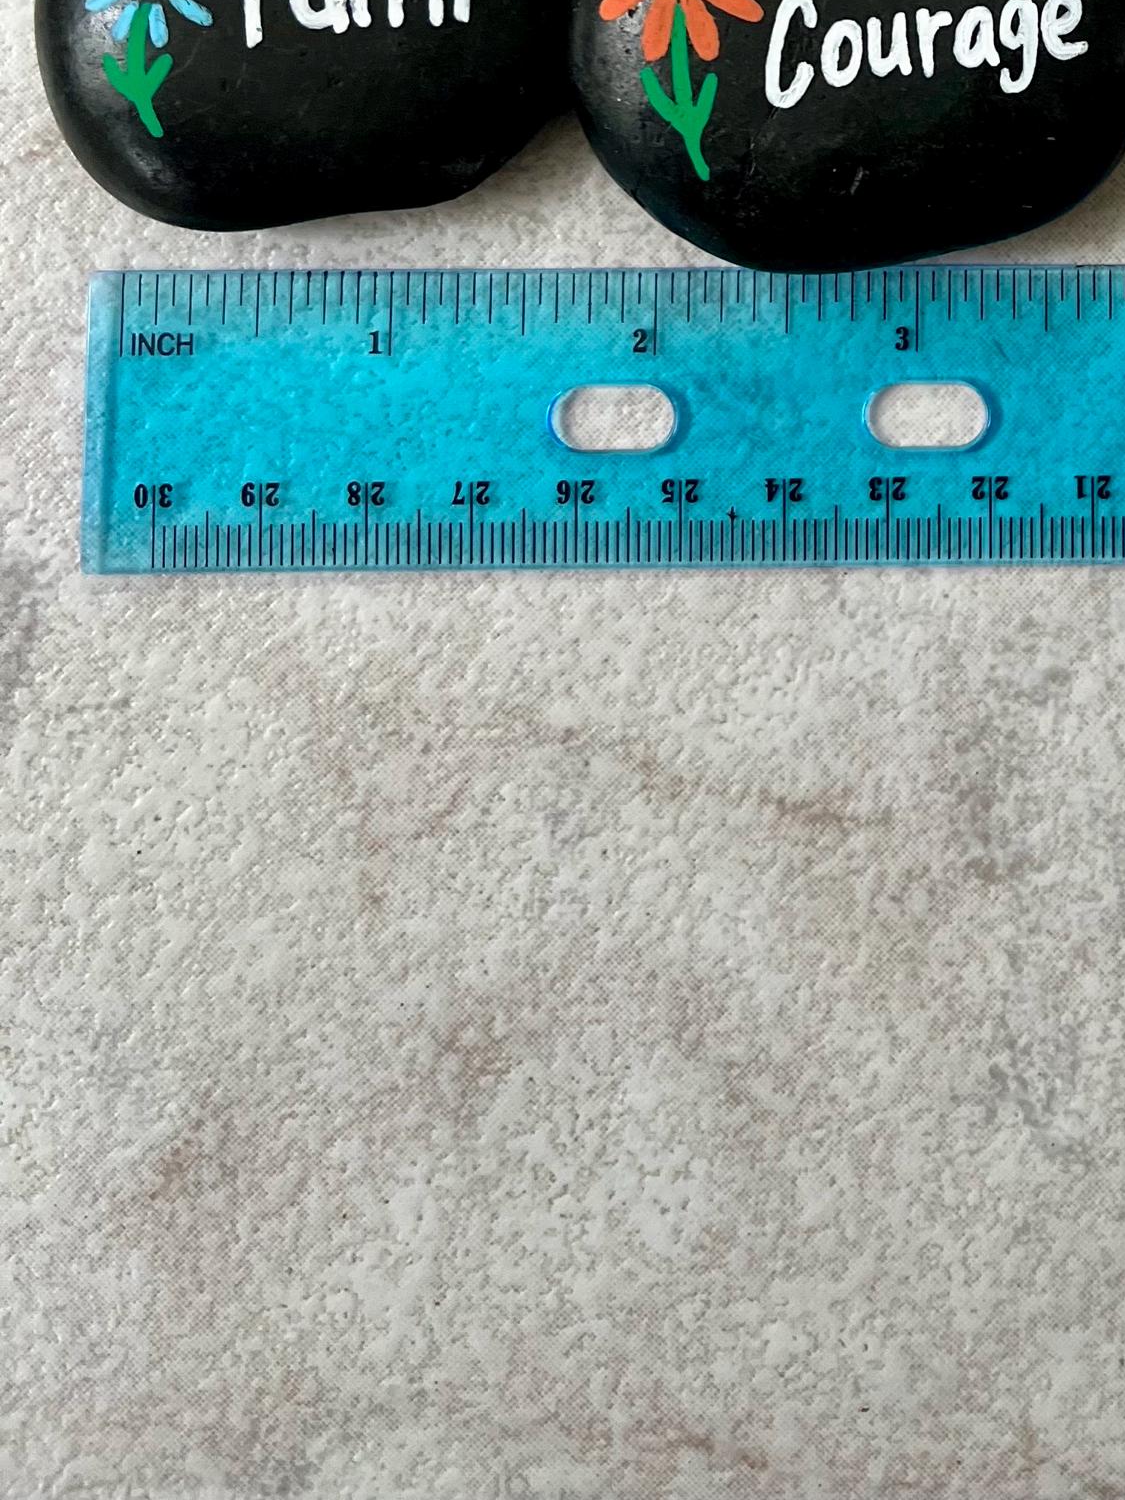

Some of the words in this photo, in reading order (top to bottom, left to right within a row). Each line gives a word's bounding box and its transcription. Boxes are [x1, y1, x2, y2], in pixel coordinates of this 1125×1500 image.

[130, 331, 194, 357] INCH
[369, 330, 382, 355] 1
[632, 328, 649, 354] 2
[894, 326, 911, 352] 3
[133, 483, 173, 509] 30
[241, 482, 280, 507] 29
[347, 481, 385, 507] 28
[451, 480, 491, 506] 27
[556, 479, 595, 505] 26
[661, 478, 700, 504] 25
[764, 477, 805, 503] 24
[868, 476, 907, 502] 23
[971, 475, 1009, 501] 22
[1074, 474, 1113, 501] 21
